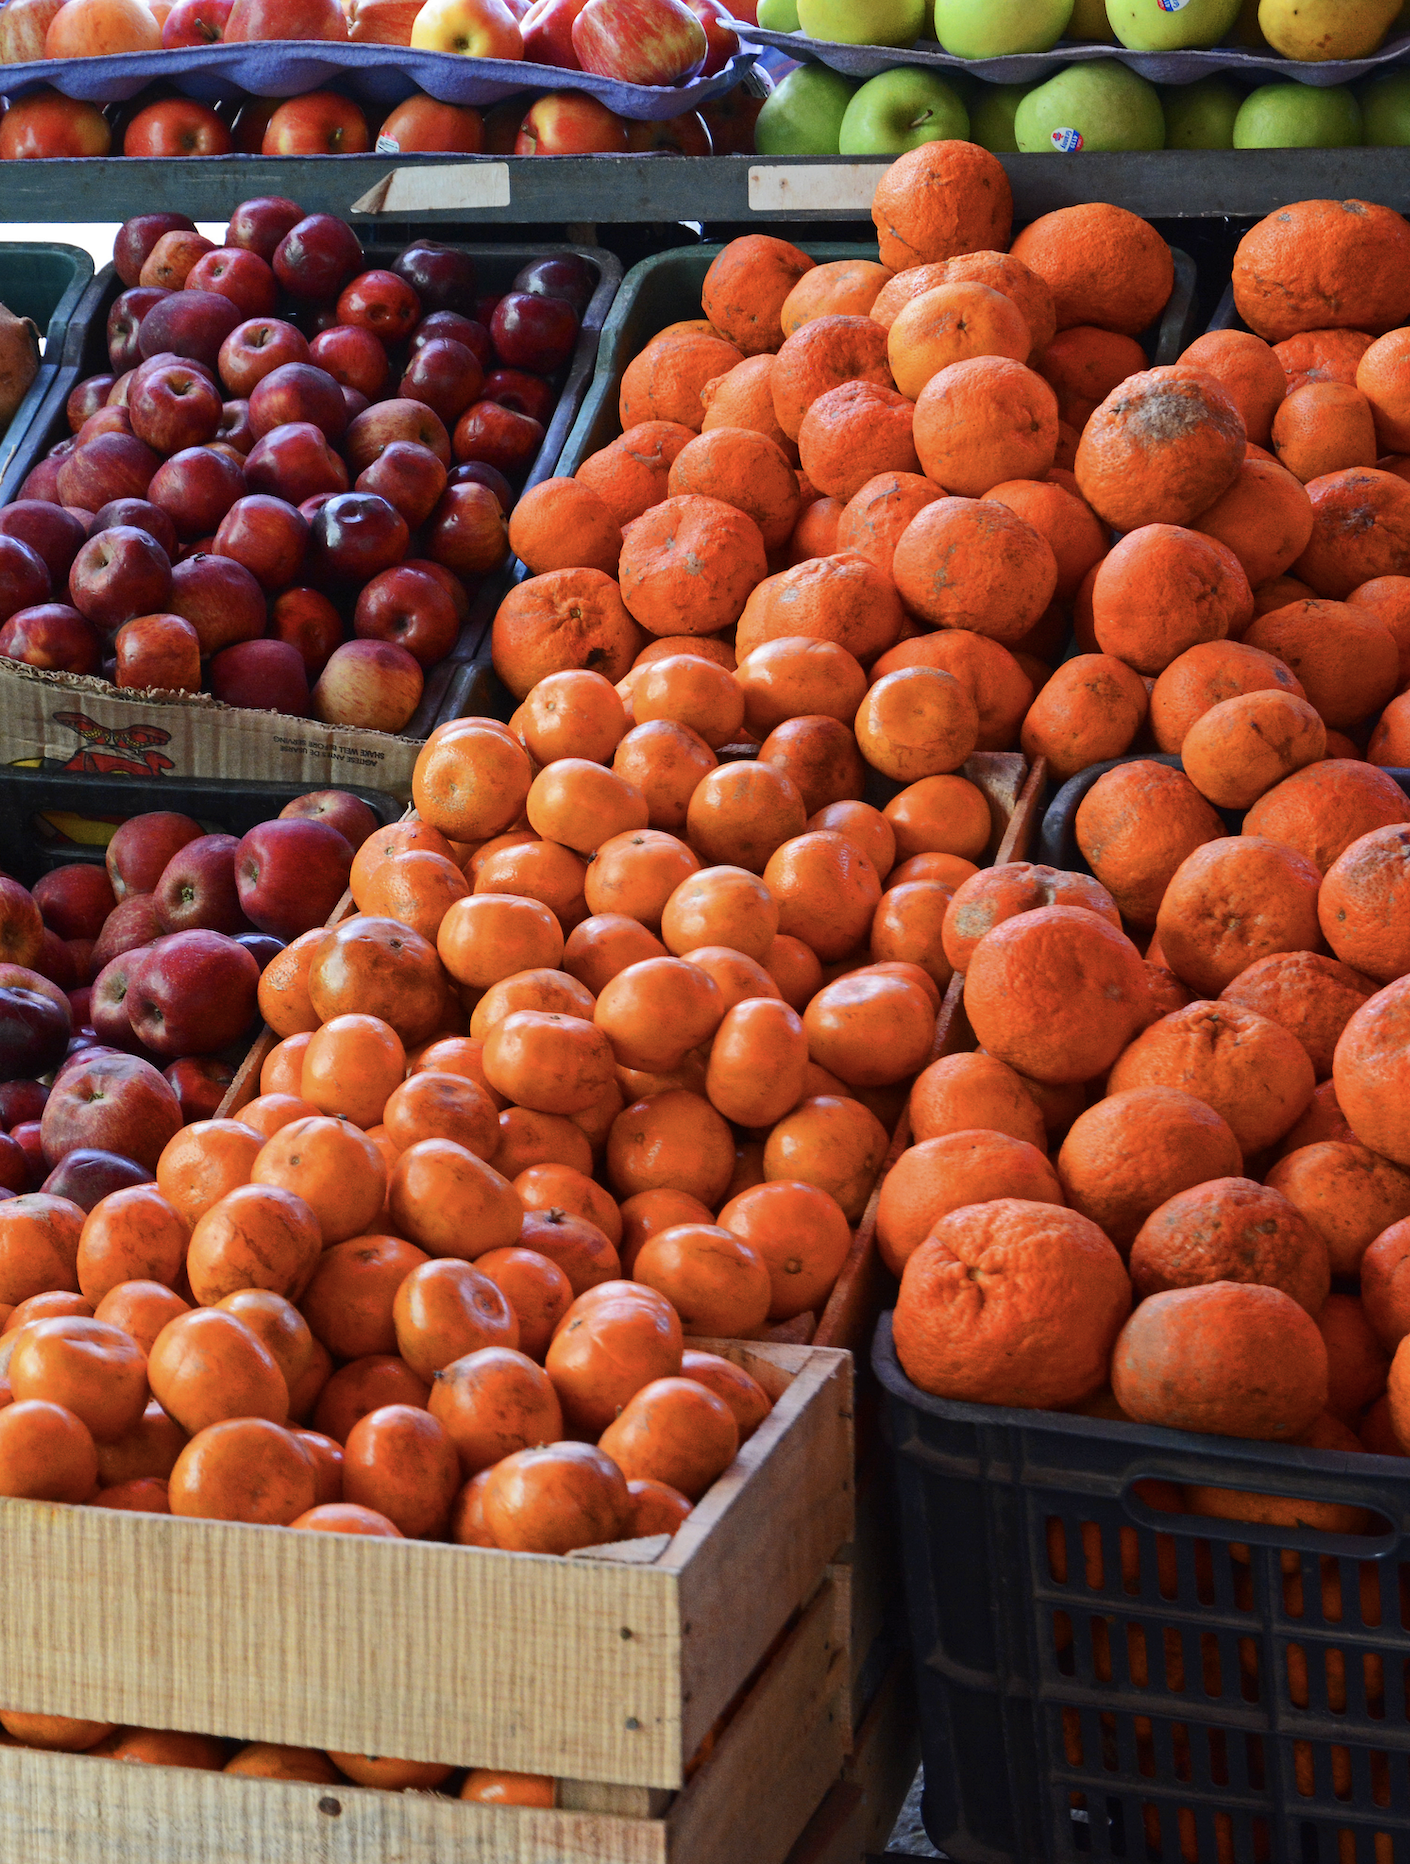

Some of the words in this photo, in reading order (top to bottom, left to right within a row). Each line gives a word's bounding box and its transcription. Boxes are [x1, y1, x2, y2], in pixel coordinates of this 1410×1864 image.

[273, 735, 306, 746] SERVING
[338, 746, 358, 755] WELL
[360, 749, 385, 760] SHAKE
